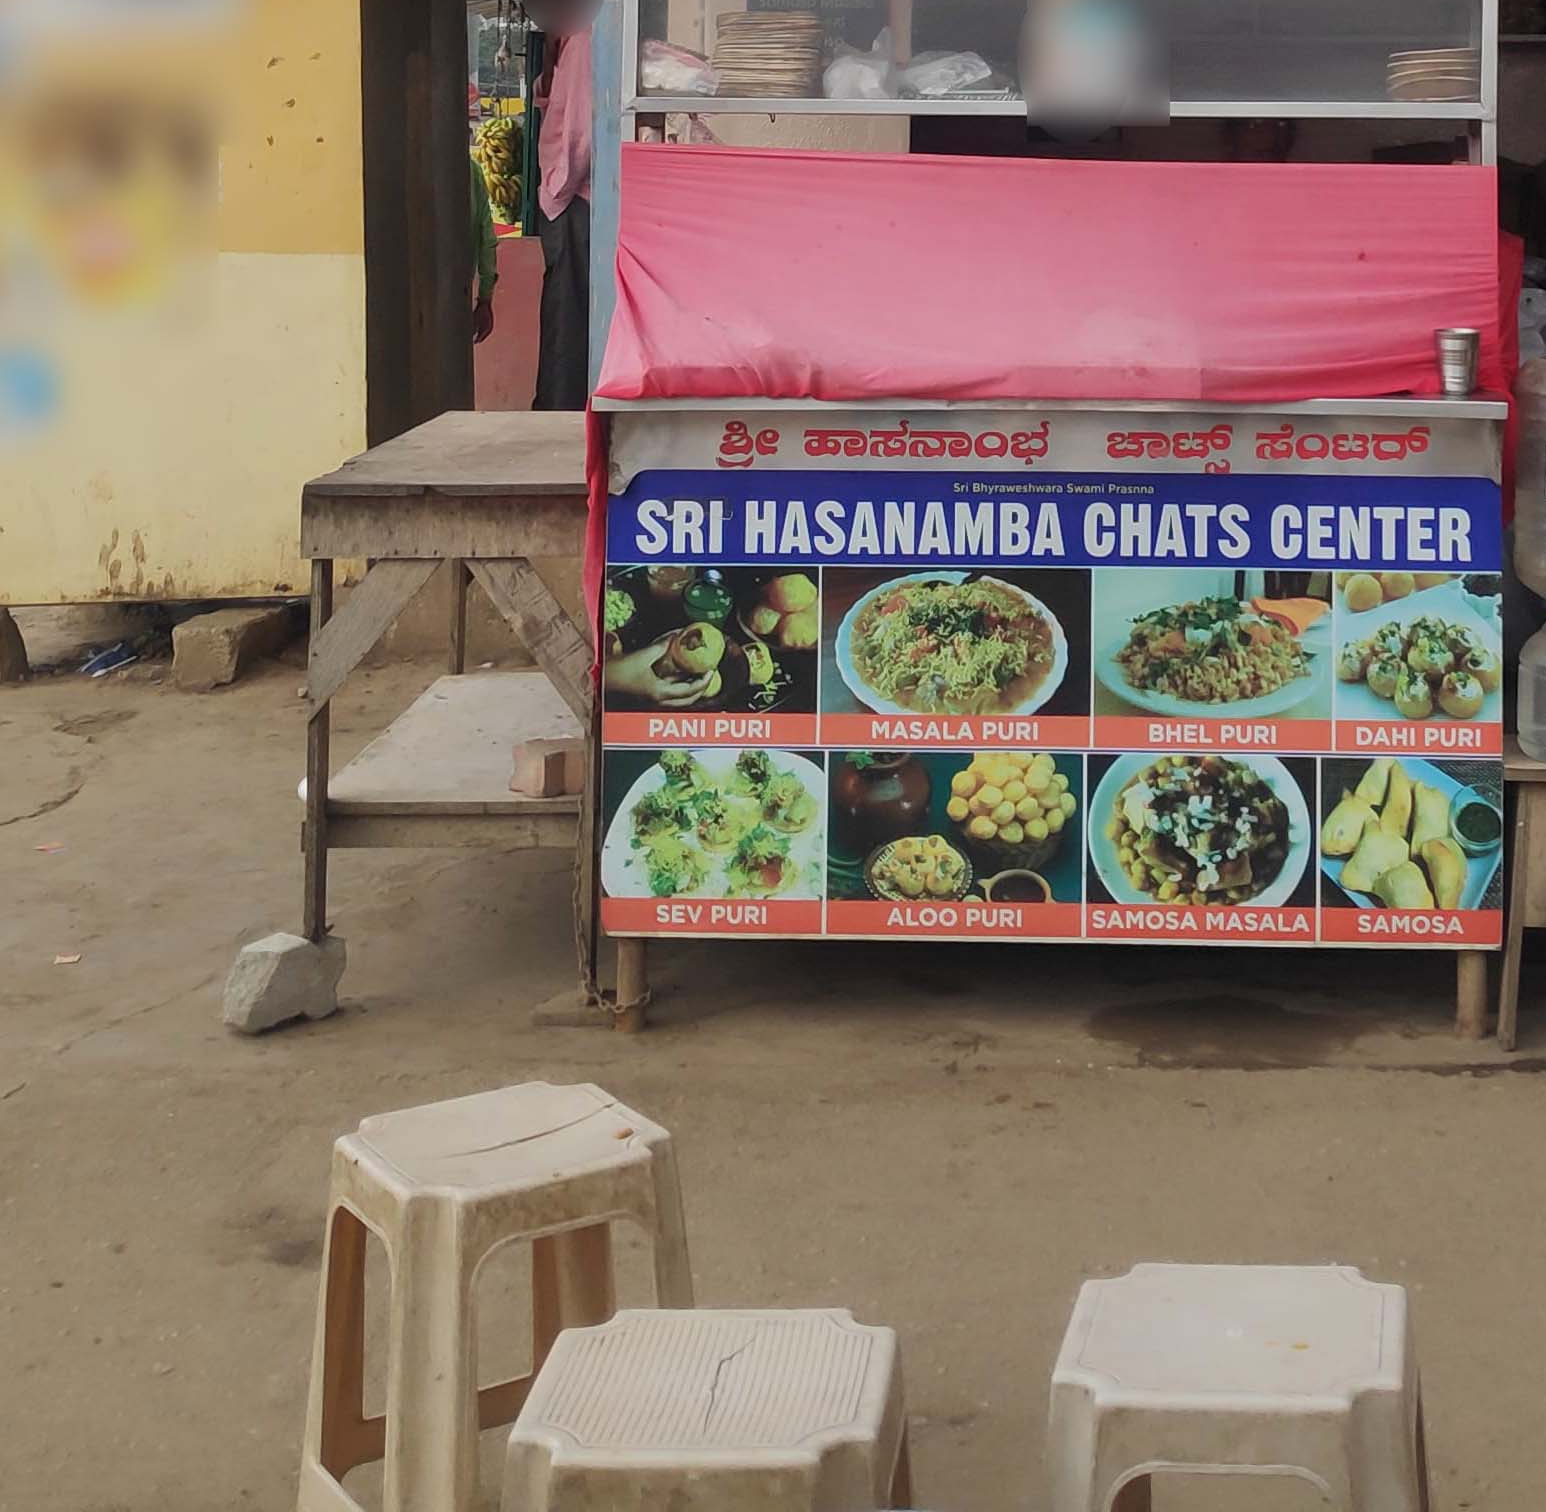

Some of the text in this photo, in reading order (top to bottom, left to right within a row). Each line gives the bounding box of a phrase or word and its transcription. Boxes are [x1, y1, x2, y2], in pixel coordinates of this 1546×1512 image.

[716, 420, 1431, 473] ಶ್ರೀ ಹಾಸನಾಂಭ ಚಾಟ್ಸ್ ಸೆಂಟರ್
[953, 482, 1154, 495] Sri Bhyraweshwara Swami Prasnna
[636, 500, 1471, 562] SRI HASANAMBA CHATS CENTER
[649, 719, 771, 738] PANI PURI
[871, 721, 1038, 740] MASALA PURI
[1148, 724, 1277, 745] BHEL PURI
[1356, 727, 1481, 748] DAHI PURI
[656, 905, 768, 925] SEV PURI
[887, 908, 1022, 929] ALOO PURI
[1092, 911, 1310, 933] SAMOSA MASALA
[1357, 914, 1464, 934] SAMOSA
